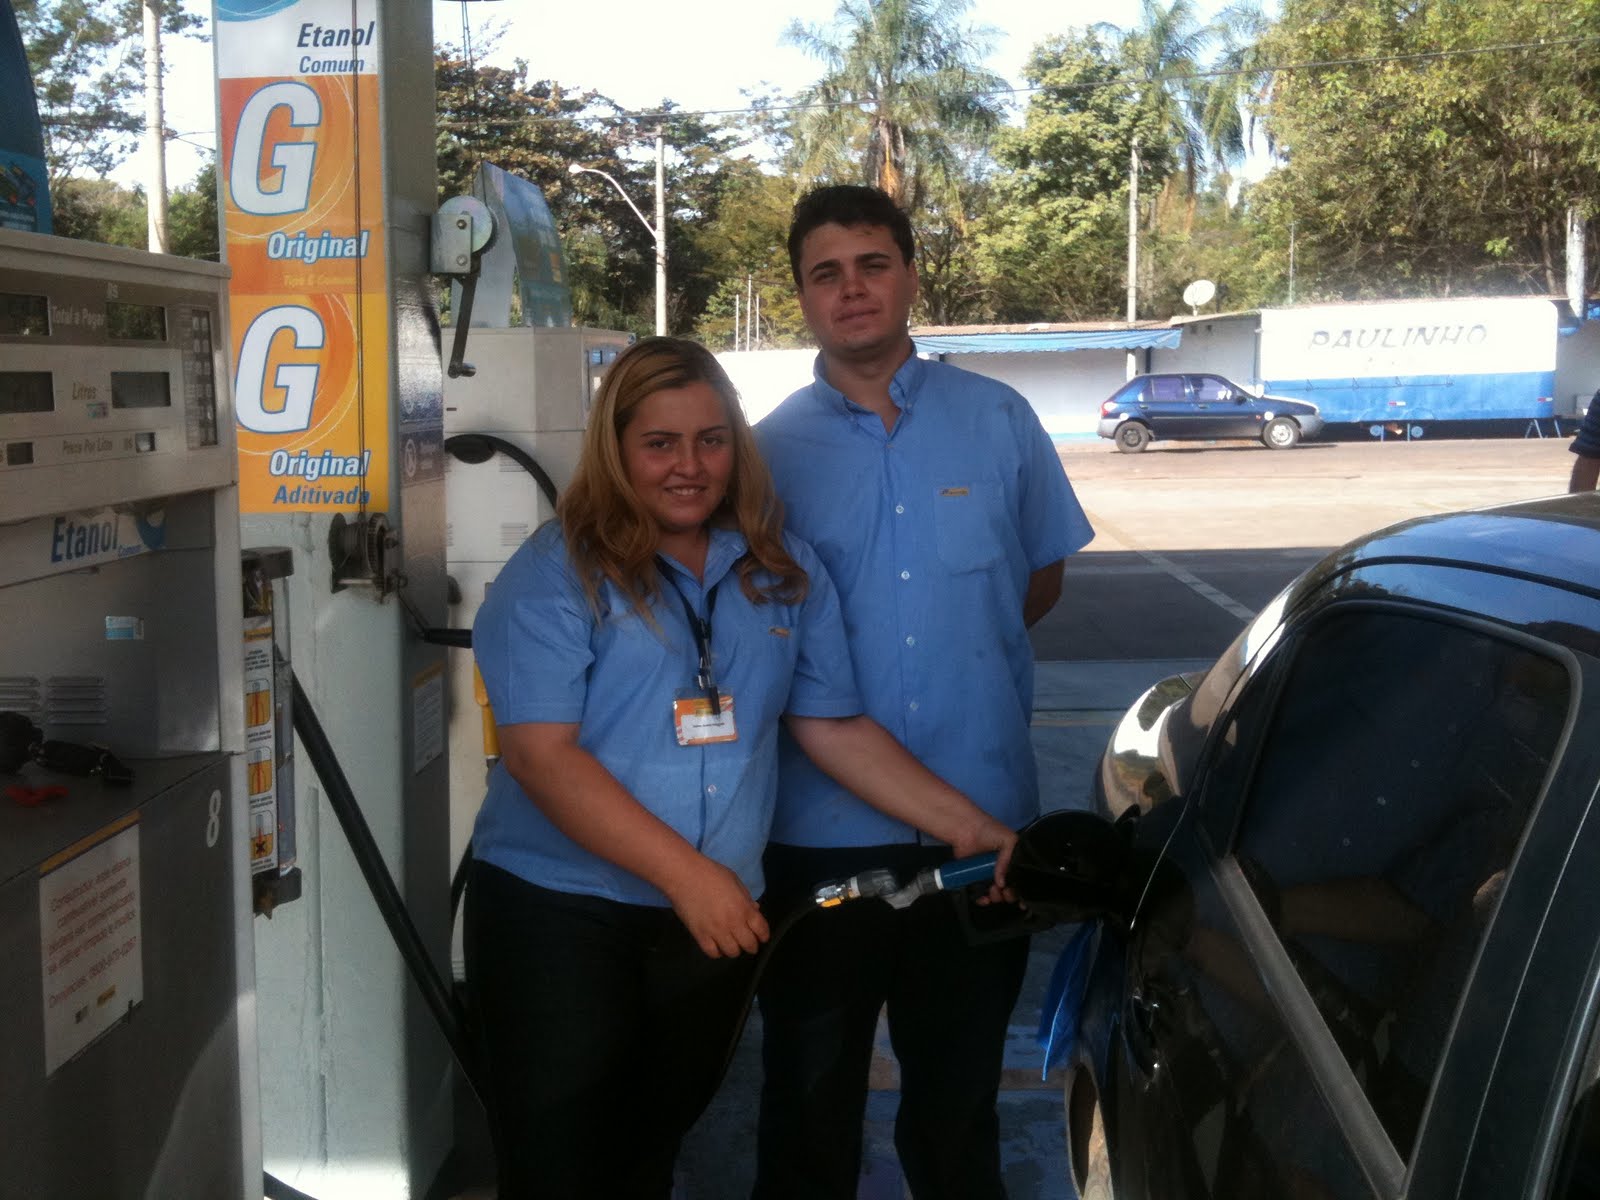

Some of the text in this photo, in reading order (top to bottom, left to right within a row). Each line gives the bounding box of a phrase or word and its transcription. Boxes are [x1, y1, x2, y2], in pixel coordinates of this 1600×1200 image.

[297, 21, 375, 48] Etanol
[299, 56, 364, 74] Comum
[229, 80, 322, 216] G
[267, 229, 370, 264] Original
[1309, 324, 1489, 349] PAULINHO
[235, 304, 325, 435] G
[269, 449, 371, 482] Original
[51, 515, 119, 563] Etanol
[206, 789, 222, 848] 8
